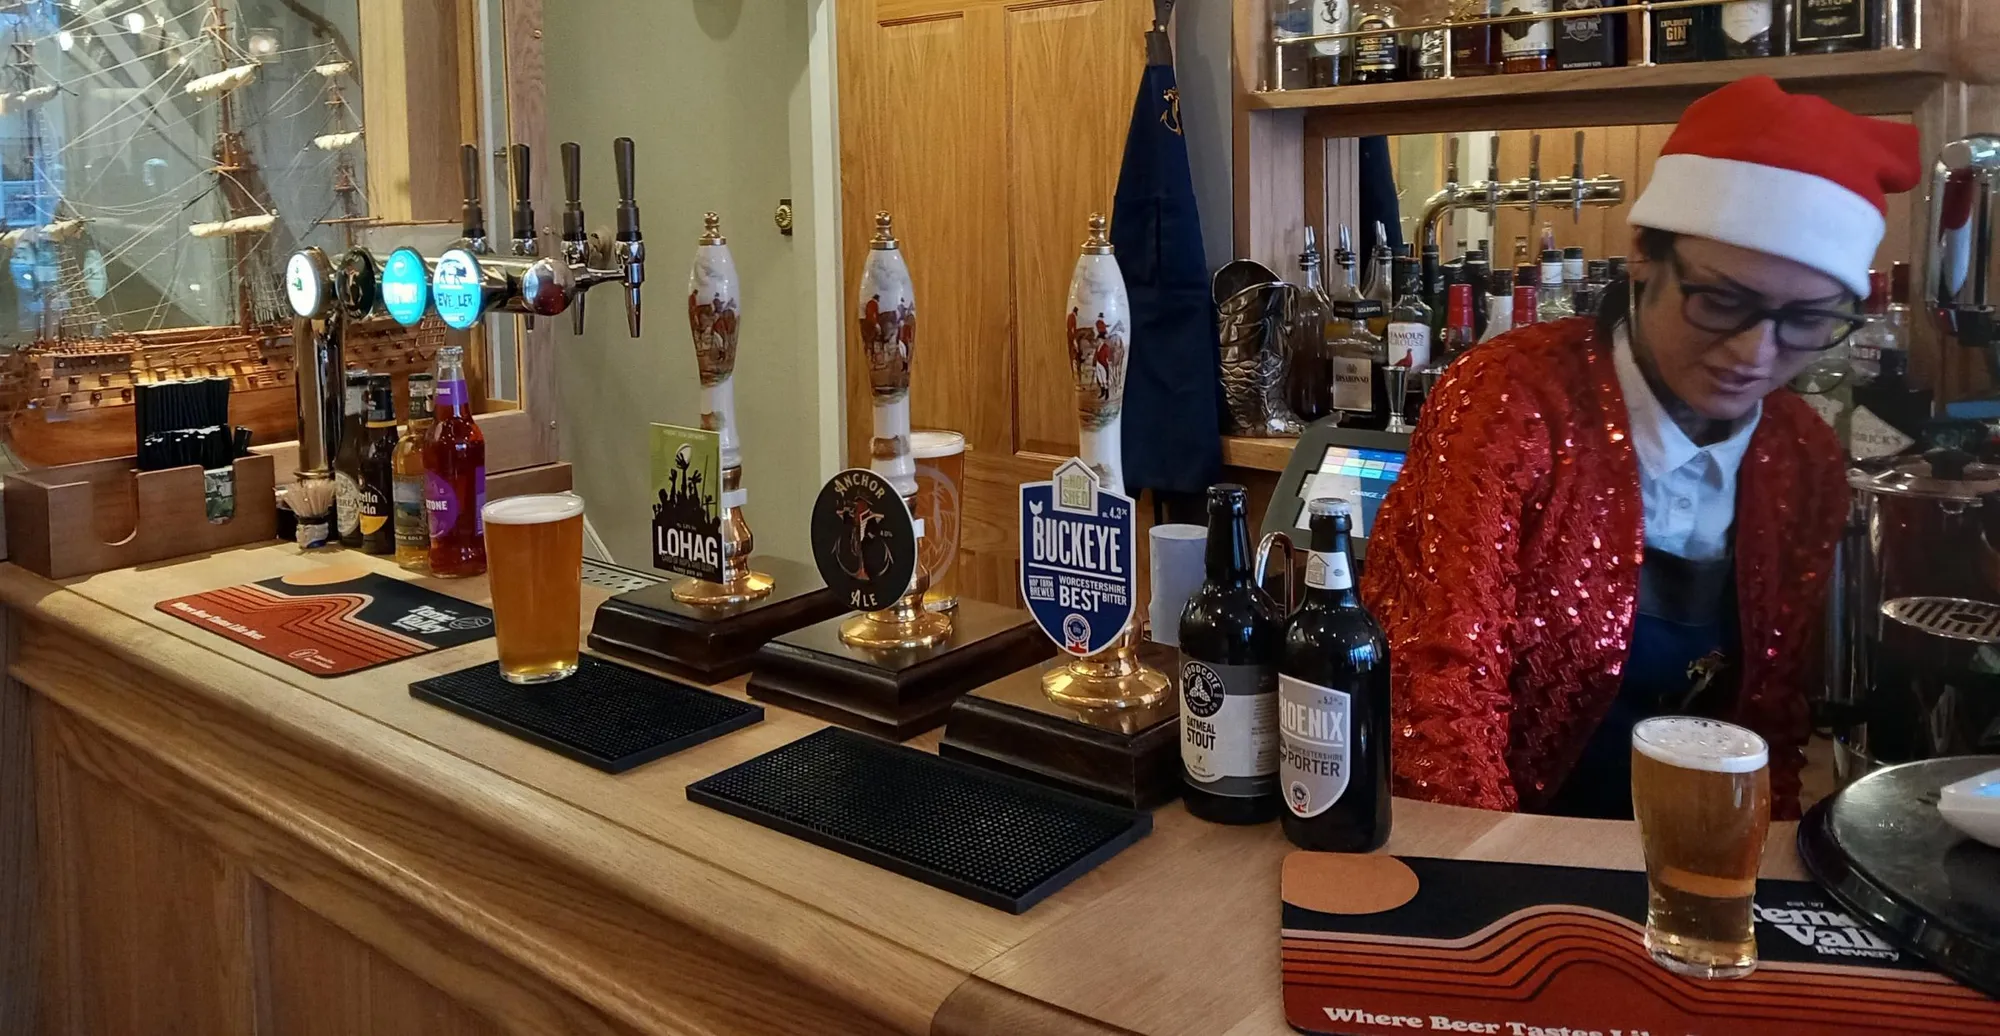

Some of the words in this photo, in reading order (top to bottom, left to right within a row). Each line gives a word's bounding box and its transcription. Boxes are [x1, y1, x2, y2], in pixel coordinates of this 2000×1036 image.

[1666, 26, 1686, 40] GIN
[1390, 331, 1425, 340] FAMOUS
[834, 473, 886, 499] ANCHOR
[1069, 474, 1087, 489] HOP
[1064, 489, 1088, 506] SHED
[657, 525, 718, 569] LOHAG
[1033, 516, 1123, 574] BUCKEYE
[1029, 586, 1055, 598] BREWED
[1059, 575, 1126, 596] WORCESTERSHIRE
[851, 589, 878, 608] ALE
[1059, 585, 1101, 613] BEST
[1102, 593, 1127, 606] BITTER
[1184, 664, 1221, 689] WOODCOTE
[1186, 715, 1216, 735] OATMEAL
[1186, 727, 1216, 751] STOUT
[1288, 751, 1341, 778] PORTER
[1815, 945, 1900, 962] Brewery
[1322, 1006, 1424, 1029] Where
[1429, 1014, 1501, 1035] Beer
